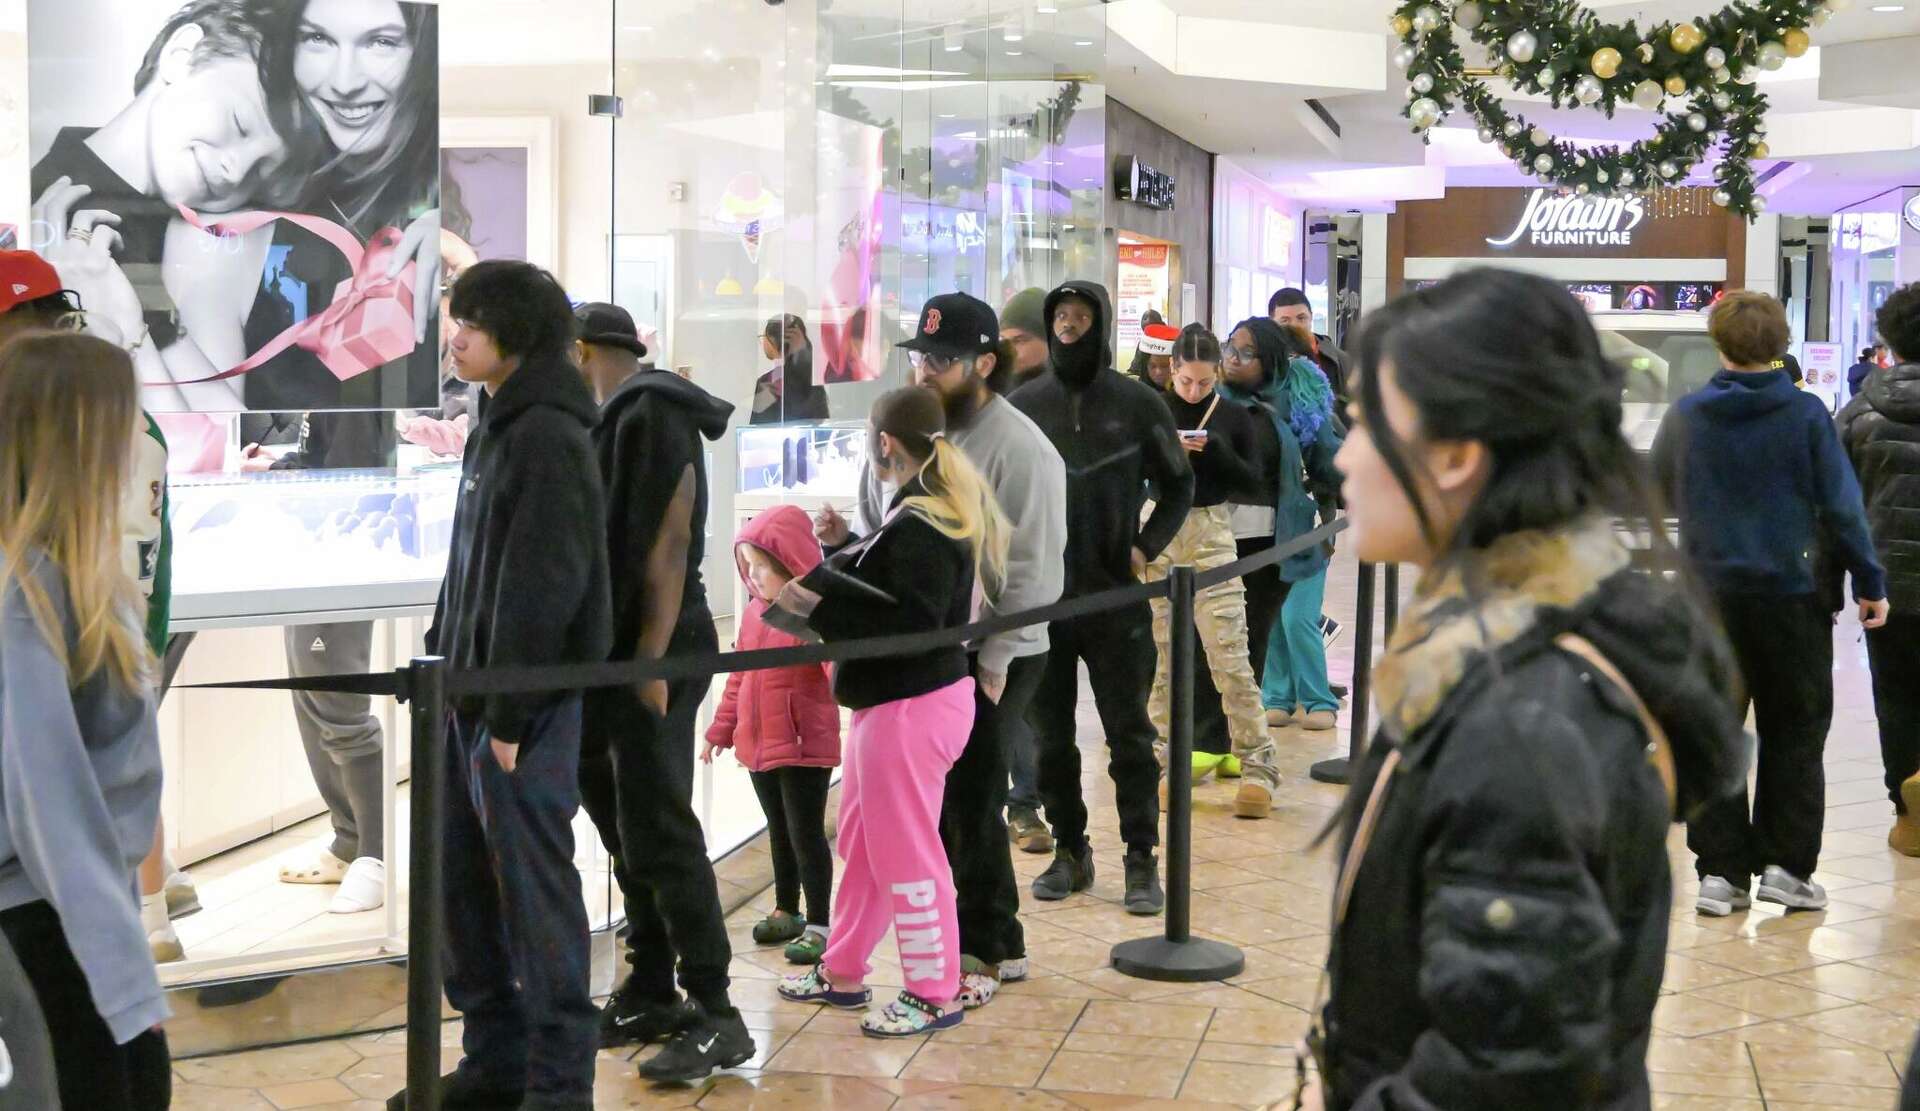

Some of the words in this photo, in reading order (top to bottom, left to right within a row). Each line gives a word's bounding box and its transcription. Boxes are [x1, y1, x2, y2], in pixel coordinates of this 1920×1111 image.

[1531, 230, 1631, 245] FURNITURE
[923, 308, 942, 335] B
[891, 879, 945, 982] PINK
